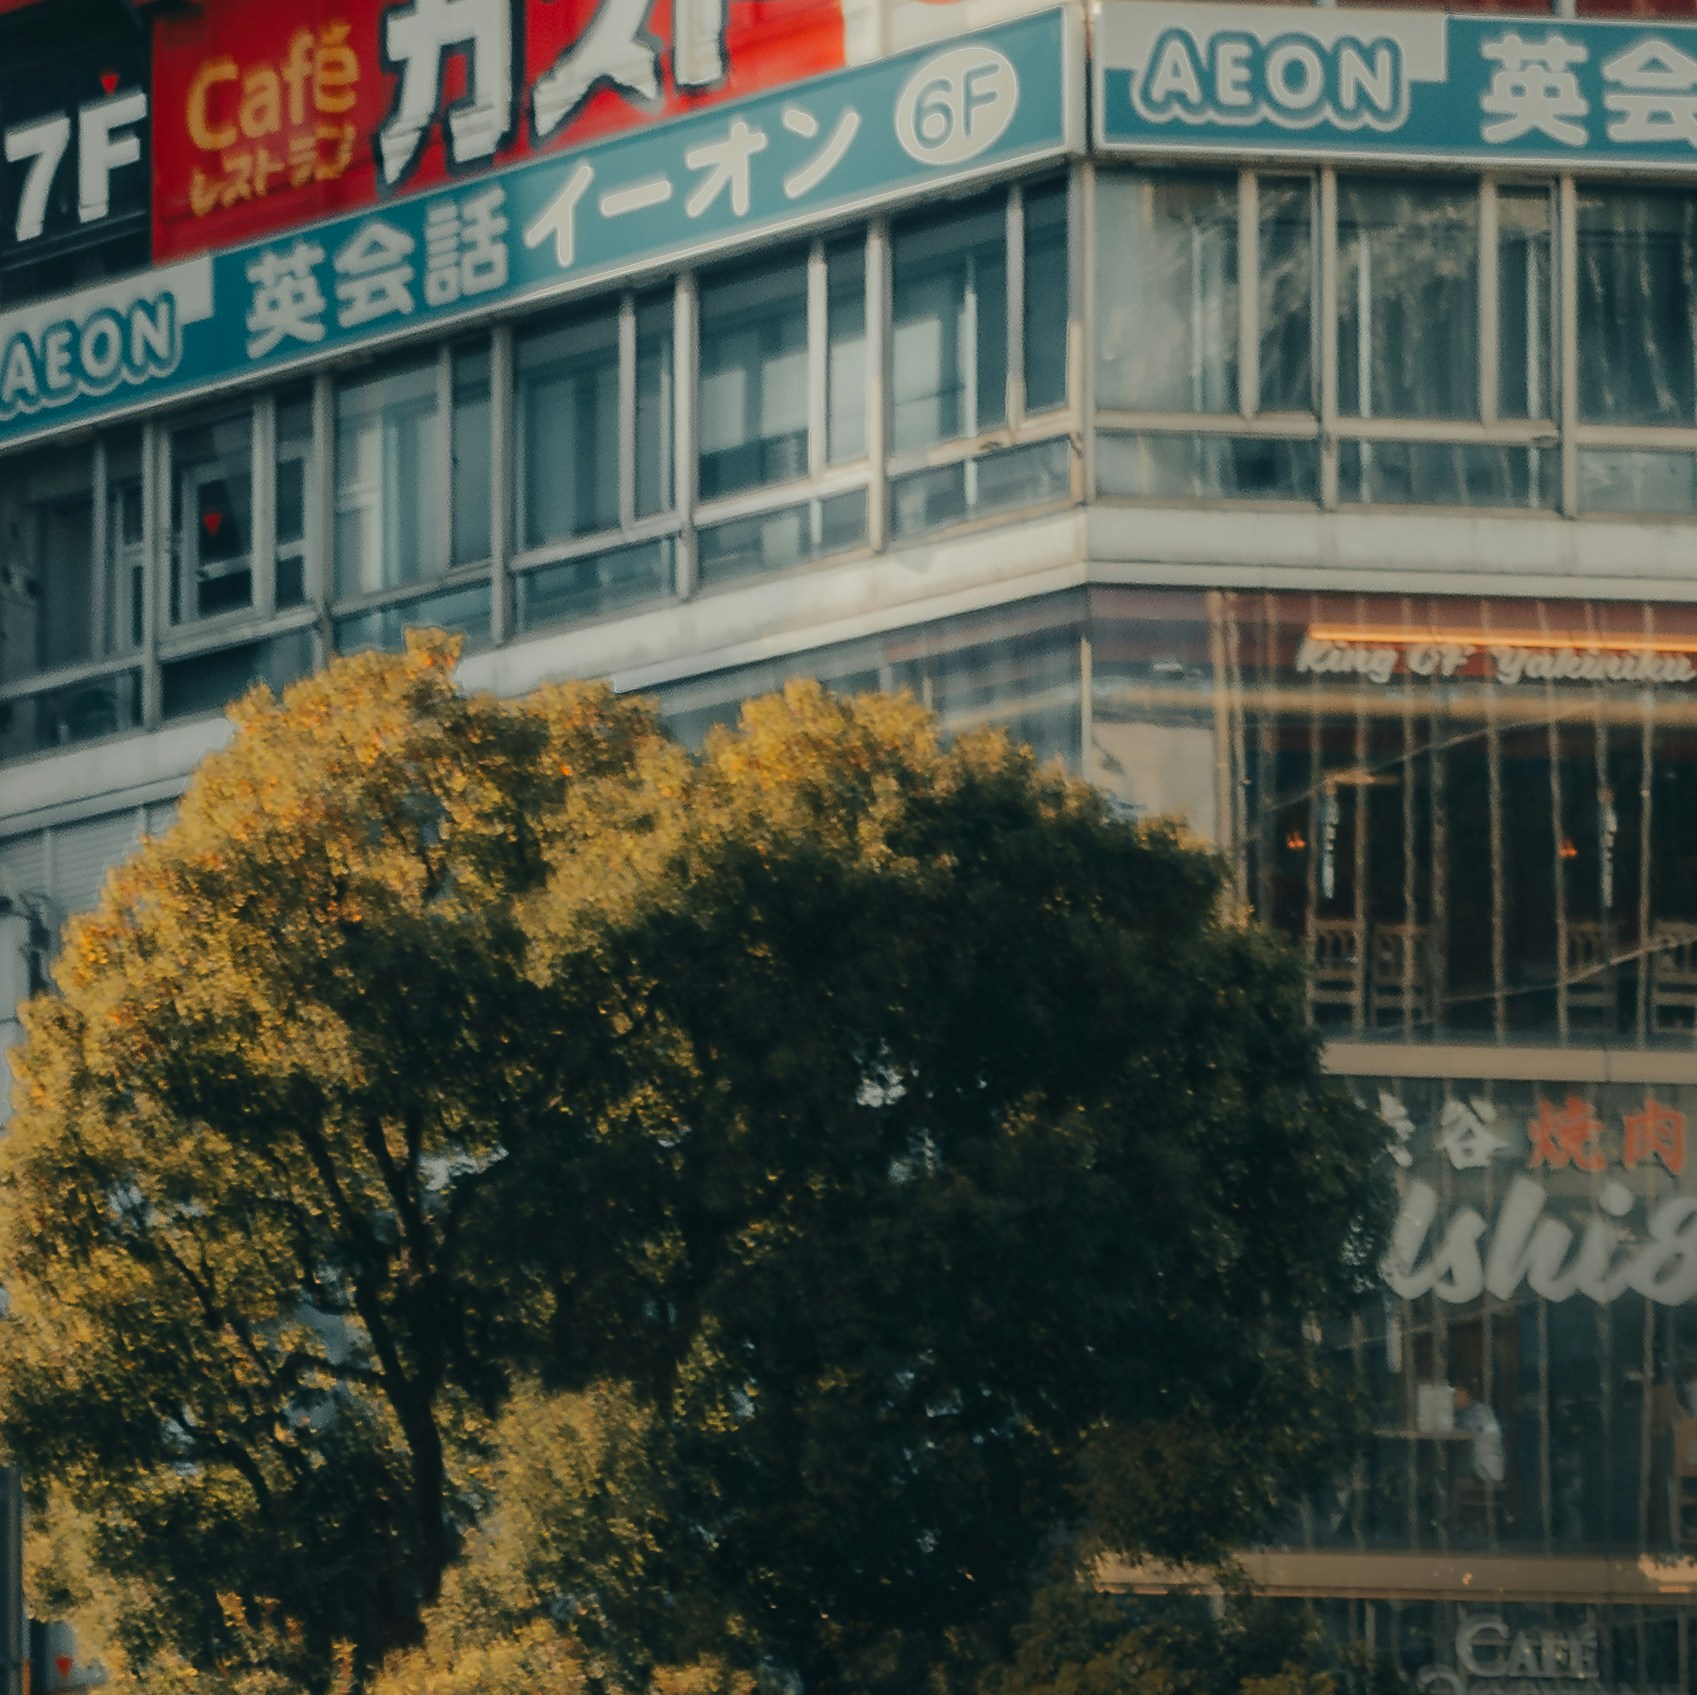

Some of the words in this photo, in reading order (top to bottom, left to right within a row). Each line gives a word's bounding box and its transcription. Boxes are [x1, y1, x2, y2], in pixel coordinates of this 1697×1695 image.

[187, 18, 359, 150] Café
[911, 62, 1002, 152] 6F
[1146, 36, 1398, 120] AEON
[4, 90, 147, 241] 7F
[188, 122, 356, 217] レストラン
